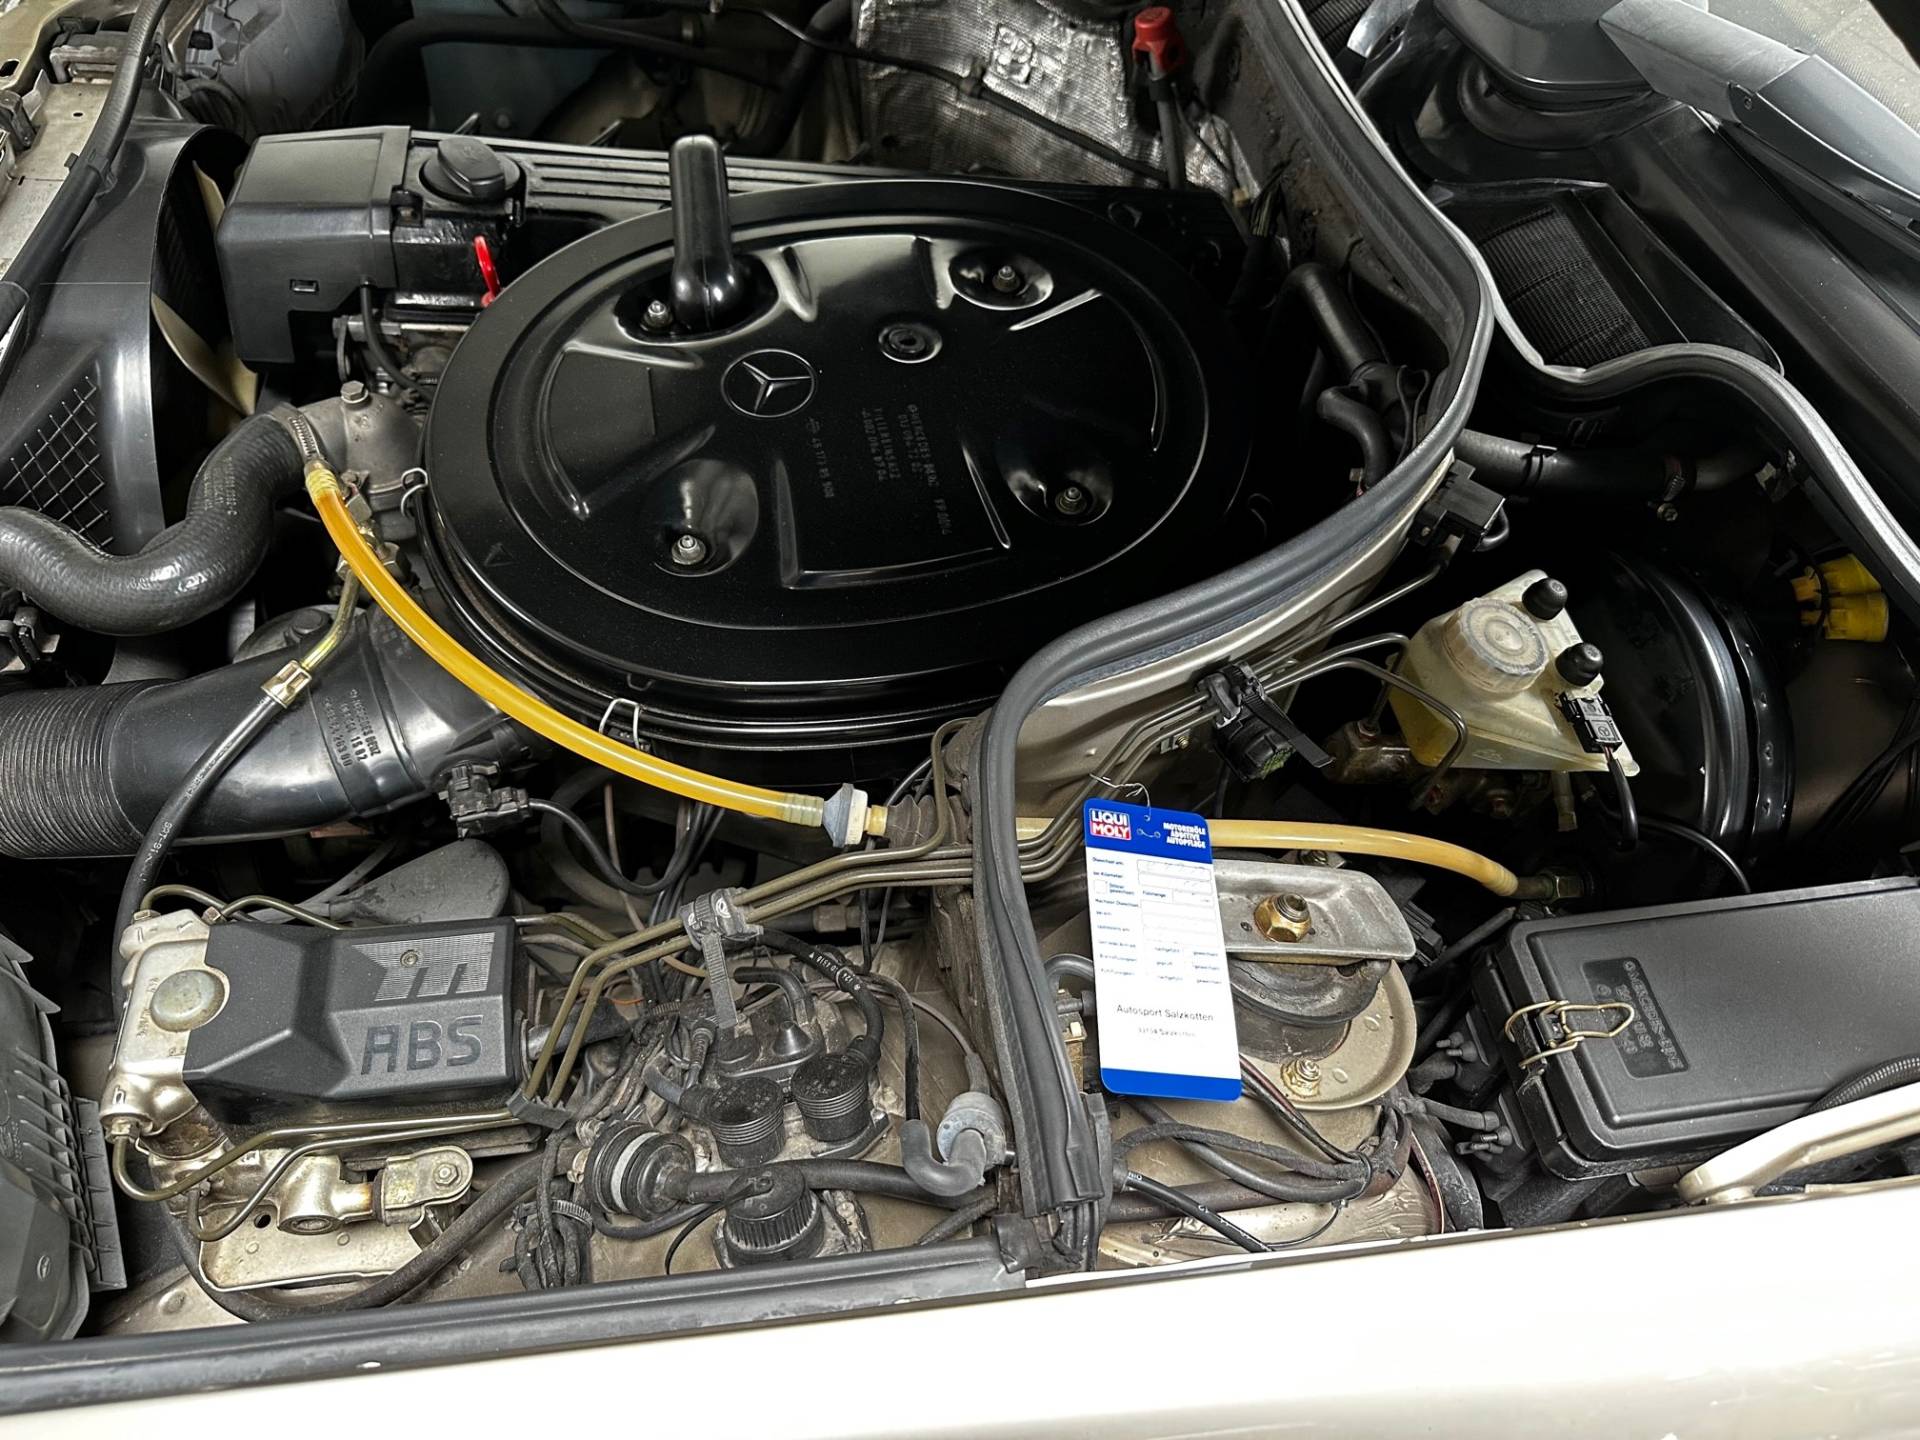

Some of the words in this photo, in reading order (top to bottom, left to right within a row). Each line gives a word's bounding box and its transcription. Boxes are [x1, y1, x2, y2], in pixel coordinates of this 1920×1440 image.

[1091, 810, 1128, 826] LIQUI
[1092, 823, 1129, 839] MOLY
[1117, 1004, 1162, 1017] Autosport
[1164, 1008, 1214, 1022] Salzkotten
[360, 1014, 484, 1075] ABS
